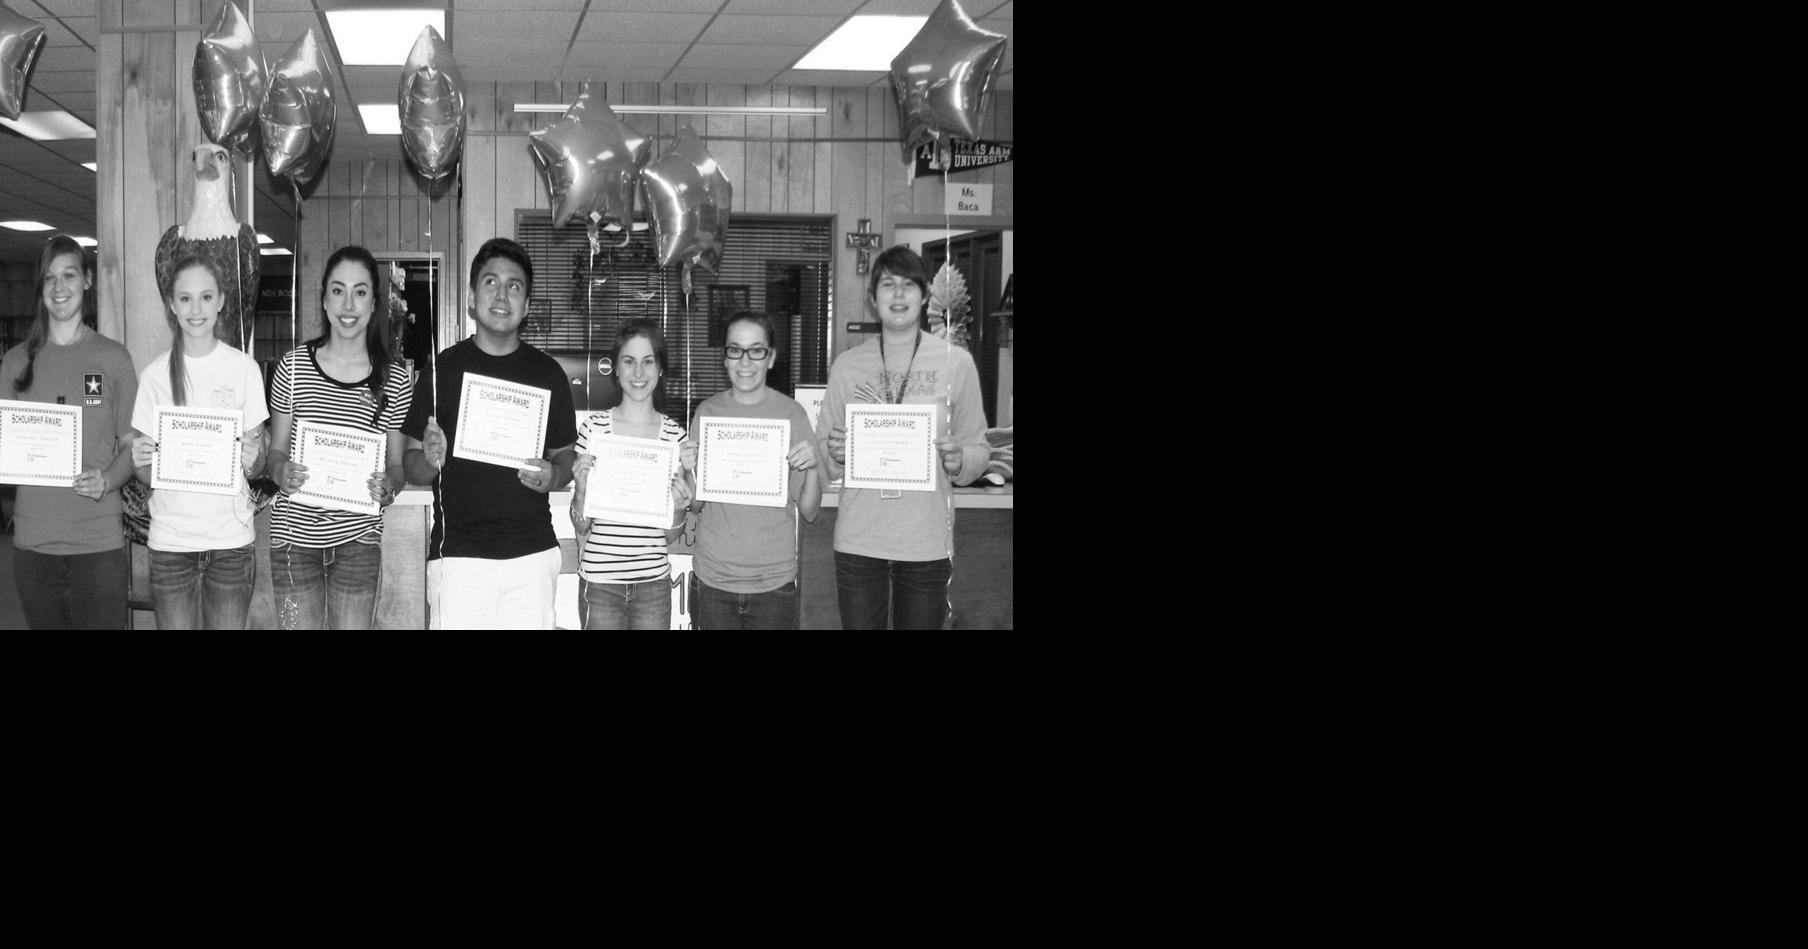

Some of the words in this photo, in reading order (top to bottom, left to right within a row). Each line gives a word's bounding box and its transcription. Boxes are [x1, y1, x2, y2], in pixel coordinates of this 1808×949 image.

[954, 141, 986, 155] TEXAS
[954, 154, 1009, 168] UNIVERSITY
[961, 187, 976, 198] Ms.
[958, 201, 979, 211] Baca
[11, 413, 44, 425] SCHOLARSHIP
[44, 415, 63, 427] AWARD
[171, 418, 204, 431] SCHOLARSHIP
[205, 420, 222, 433] AWARD
[864, 418, 897, 429] SCHOLARSHIP
[898, 418, 916, 430] AWARD
[717, 429, 750, 441] SCHOLARSHIP
[750, 430, 769, 442] AWARD
[314, 435, 348, 449] SCHOLARSHIP
[347, 440, 366, 454] AWARD
